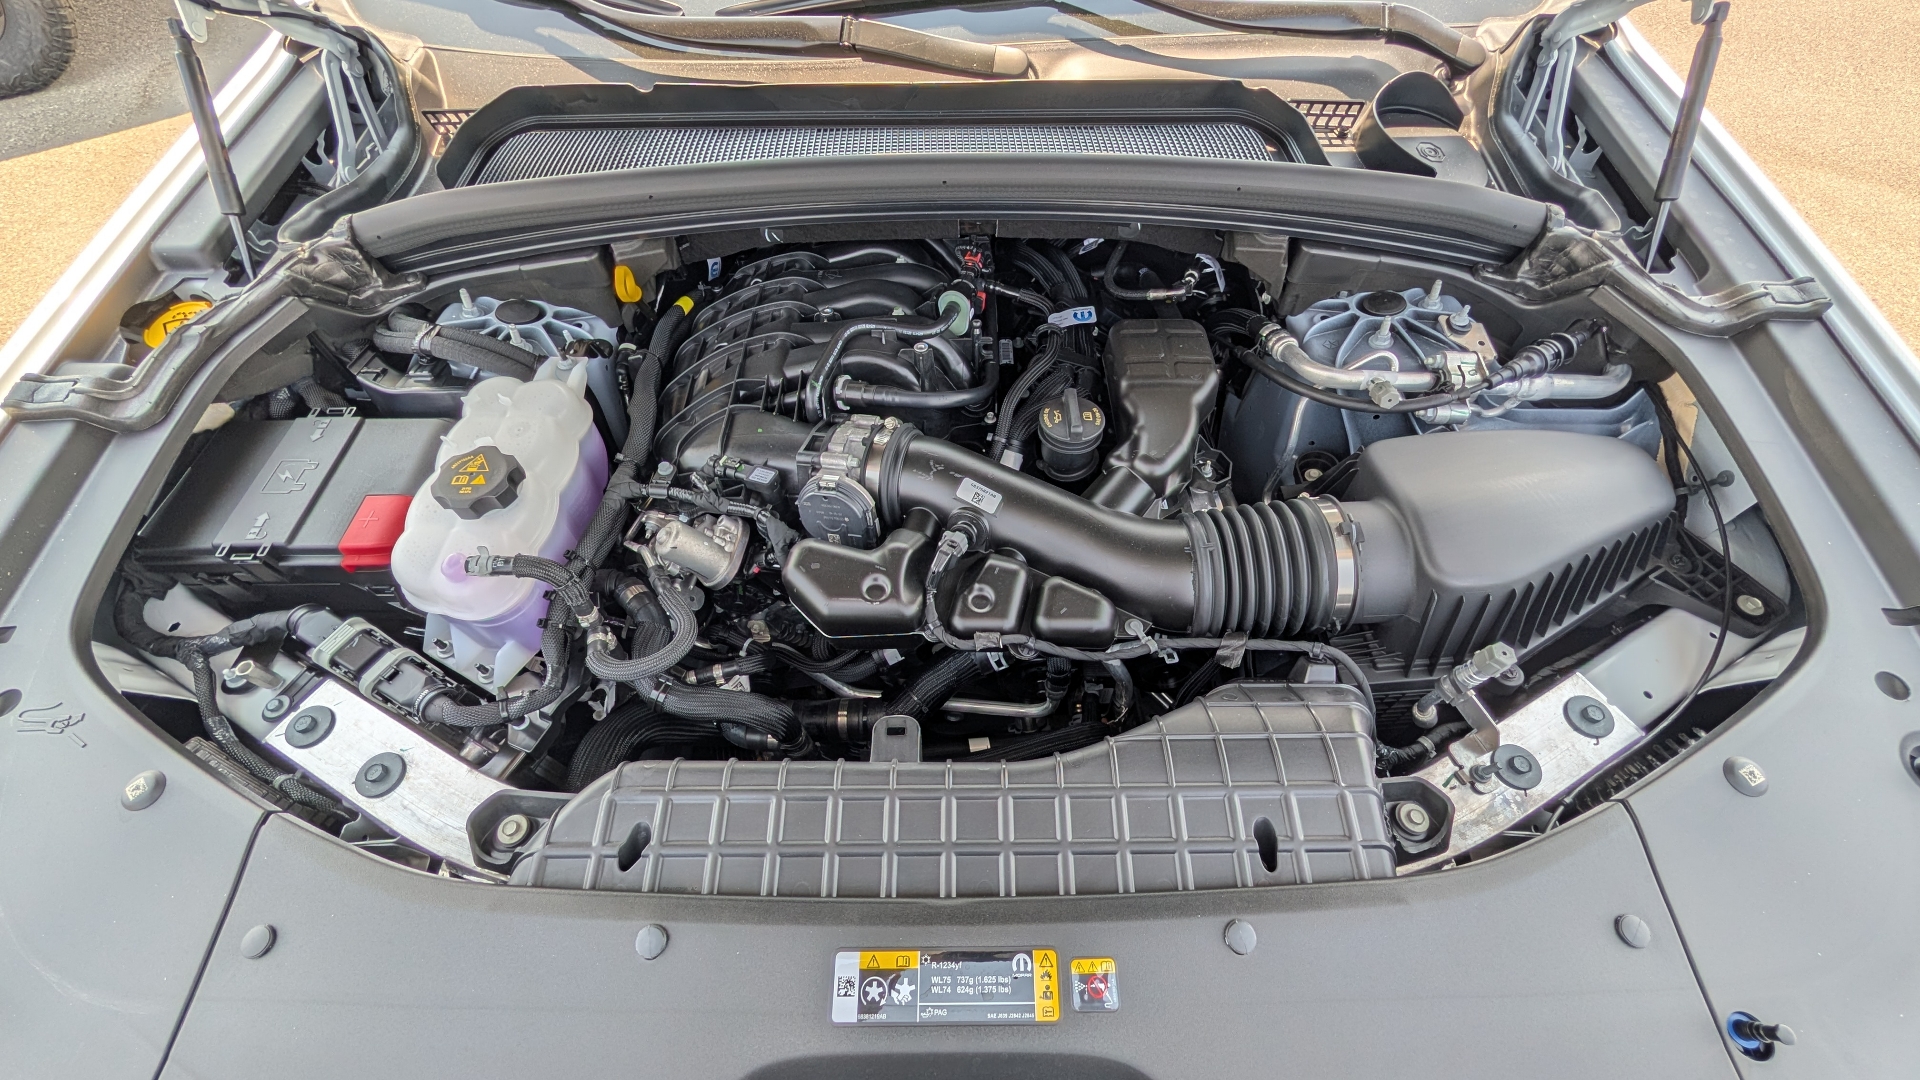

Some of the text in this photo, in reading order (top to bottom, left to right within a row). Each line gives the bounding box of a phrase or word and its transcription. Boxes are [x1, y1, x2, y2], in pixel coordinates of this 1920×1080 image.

[931, 961, 962, 971] R-1234yf
[931, 975, 1011, 985] WL75 737g (1.625 lbs)
[931, 985, 1011, 995] WL74 624g (1.375 lbs)
[933, 1008, 948, 1016] PAG
